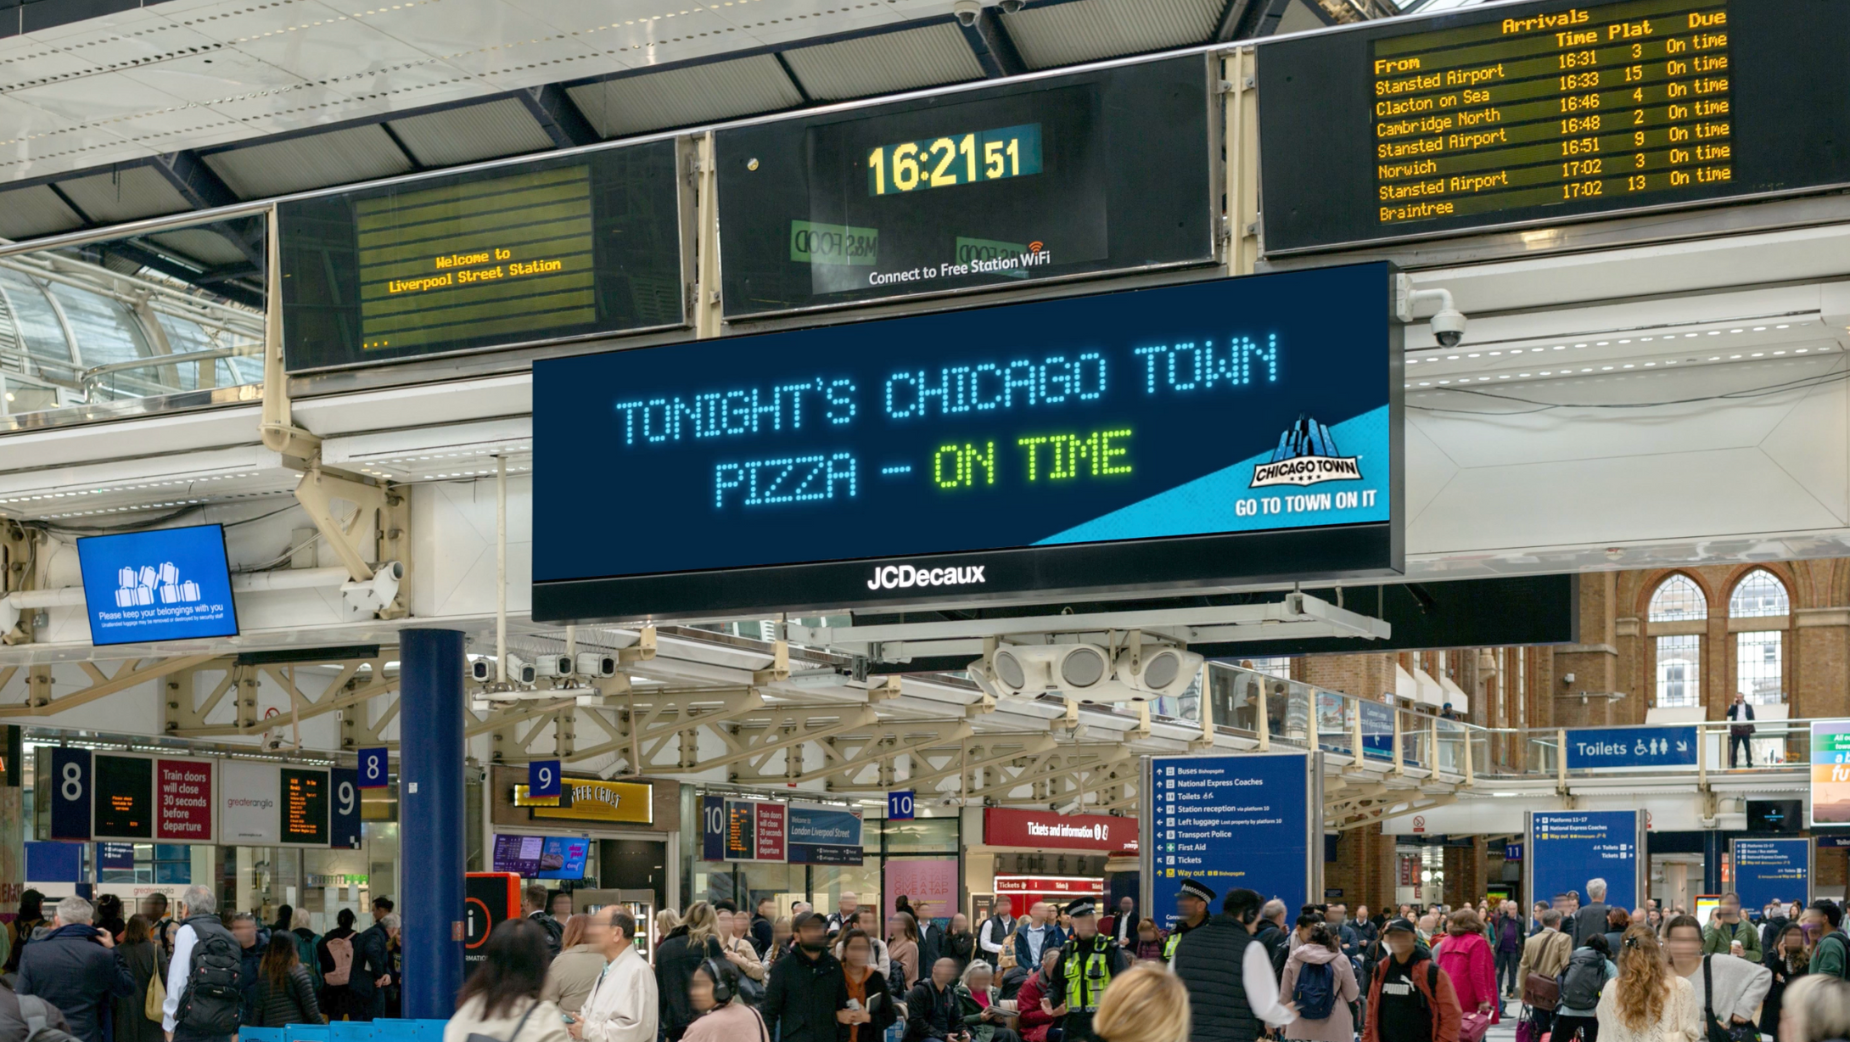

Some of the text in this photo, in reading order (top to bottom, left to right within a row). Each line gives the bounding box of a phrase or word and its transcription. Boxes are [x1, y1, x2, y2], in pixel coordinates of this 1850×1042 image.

[1502, 9, 1589, 34] Arrivals
[1375, 10, 1726, 74] From Time Plat Due
[1376, 33, 1728, 96] Stansted Airport 16:31 3 On time
[1376, 55, 1728, 116] Clacton on Sea 16:33 15 On time
[1377, 77, 1728, 138] Cambridge North 16:46 4 On time
[1378, 100, 1729, 159] Stansted Airport 16:48 2 On time
[1379, 122, 1730, 180] Norwich 16:51 9 On time
[1379, 144, 1730, 201] Stansted Airport 17:02 3 On time
[1380, 166, 1731, 222] Braintree 17:02 13 On time
[436, 248, 510, 269] Welcome to
[869, 250, 1051, 286] Connect to Free Station WiFi
[389, 260, 561, 294] Liverpool Street Station
[616, 333, 1276, 445] TONIGHT'S CHICAGO TOWN
[716, 452, 856, 508] PIZZA
[935, 441, 994, 488] ON
[1018, 429, 1132, 481] TIME
[1256, 460, 1357, 482] CHICAGO TOWN
[1235, 489, 1377, 517] GO TO TOWN ON IT
[867, 564, 986, 590] JCDecaux
[99, 604, 224, 621] Please keep your belongings with you
[1834, 734, 1844, 742] All
[1577, 740, 1627, 757] Toilets
[1835, 754, 1843, 763] a
[163, 769, 206, 783] Train doors
[367, 755, 380, 780] 8
[62, 762, 82, 800] 8
[538, 767, 552, 790] 9
[1178, 778, 1263, 788] National Express Coaches
[163, 783, 199, 794] will close
[163, 794, 207, 807] 30 seconds
[338, 781, 354, 815] 9
[594, 786, 622, 809] CRUST
[891, 797, 912, 815] 10
[163, 807, 189, 819] before
[759, 810, 782, 820] Train doors
[1203, 805, 1236, 814] reception
[163, 820, 202, 833] departure
[705, 806, 724, 835] 10
[768, 820, 779, 828] close
[791, 816, 807, 824] Welcome
[1178, 818, 1192, 826] Left
[1193, 817, 1220, 827] luggage
[759, 829, 782, 837] 30 seconds
[791, 825, 850, 839] London Liverpool Street
[1027, 821, 1093, 838] Tickets and information
[1178, 830, 1232, 840] Transport Police
[759, 837, 773, 846] before
[1178, 843, 1207, 851] First Aid
[759, 847, 780, 856] departure
[1508, 847, 1519, 857] 11
[894, 888, 949, 896] GIVE A TAP
[1382, 983, 1409, 996] PUMA
